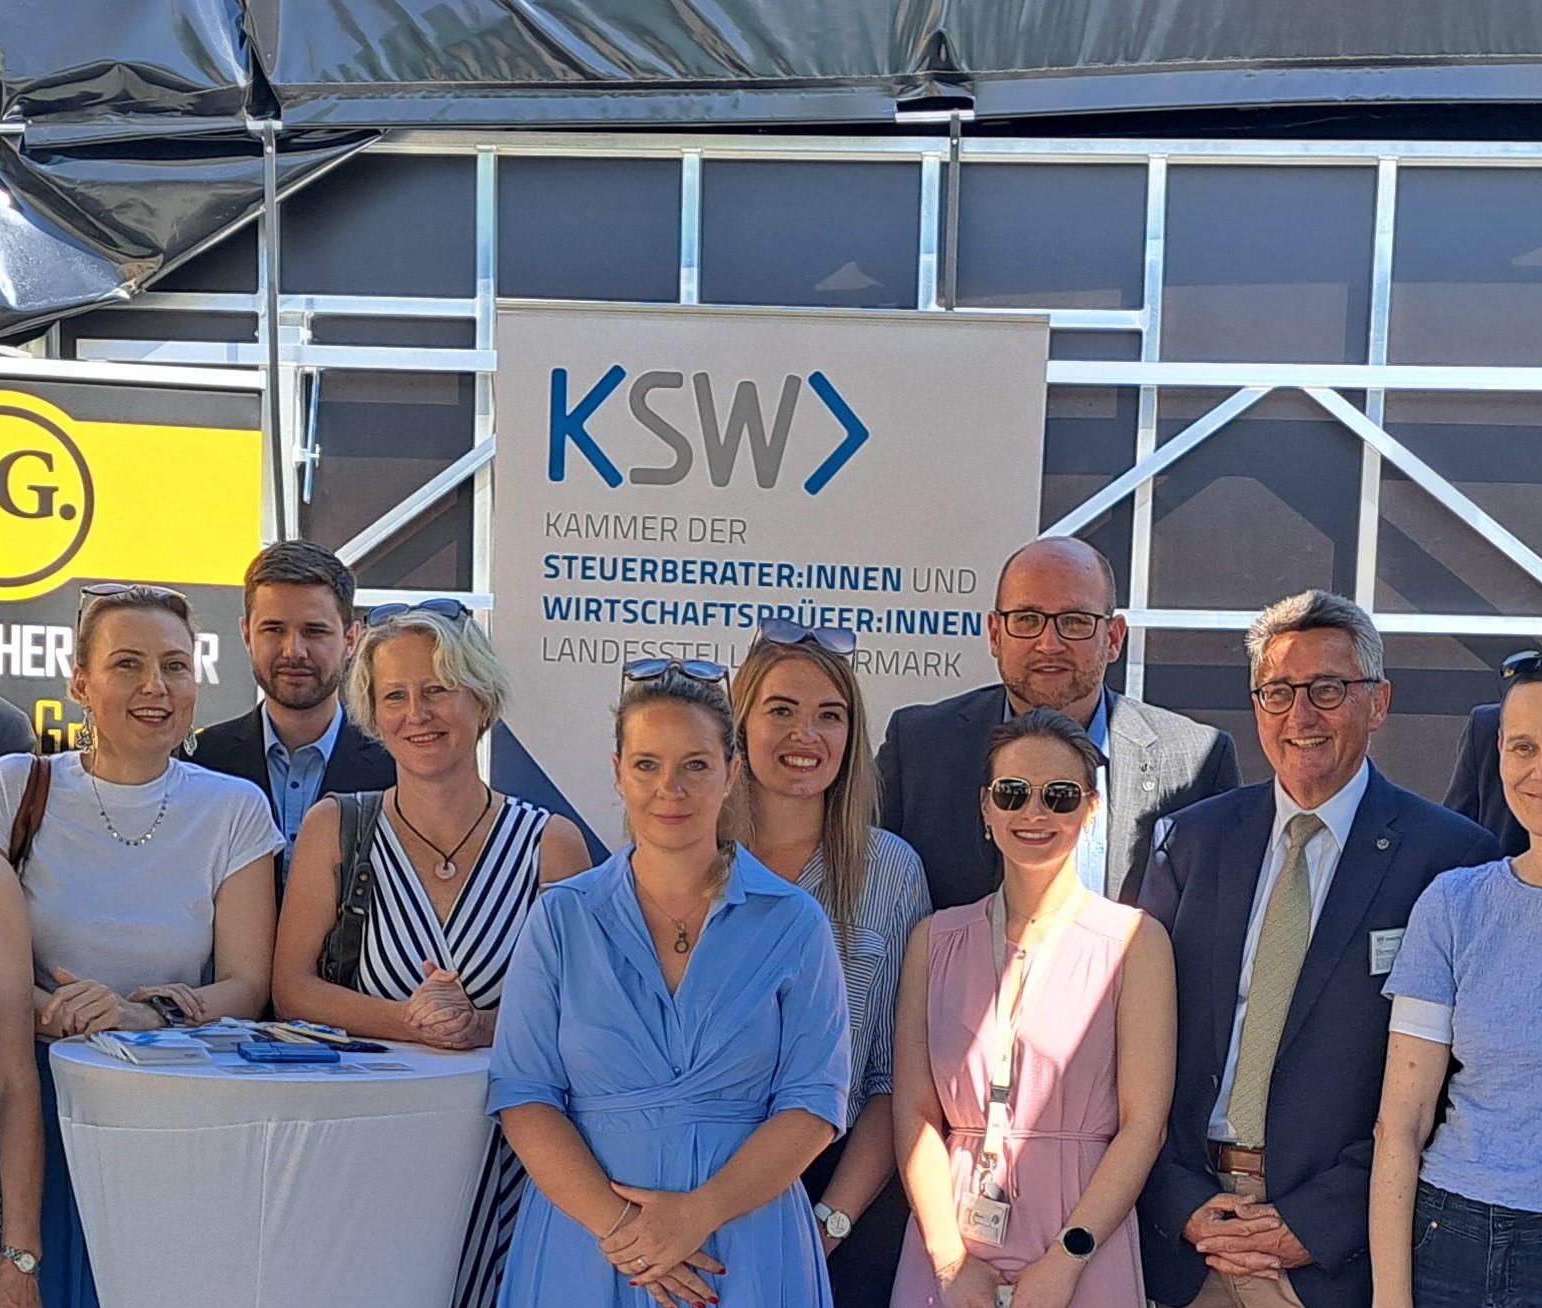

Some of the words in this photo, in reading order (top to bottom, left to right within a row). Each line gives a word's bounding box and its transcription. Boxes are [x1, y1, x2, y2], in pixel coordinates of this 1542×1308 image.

[548, 364, 802, 489] KSW
[545, 511, 678, 542] KAMMER
[688, 517, 747, 544] DER
[543, 554, 902, 592] STEUERBERATER:INNEN
[912, 567, 977, 594] UND
[543, 637, 743, 669] LANDESSTELL
